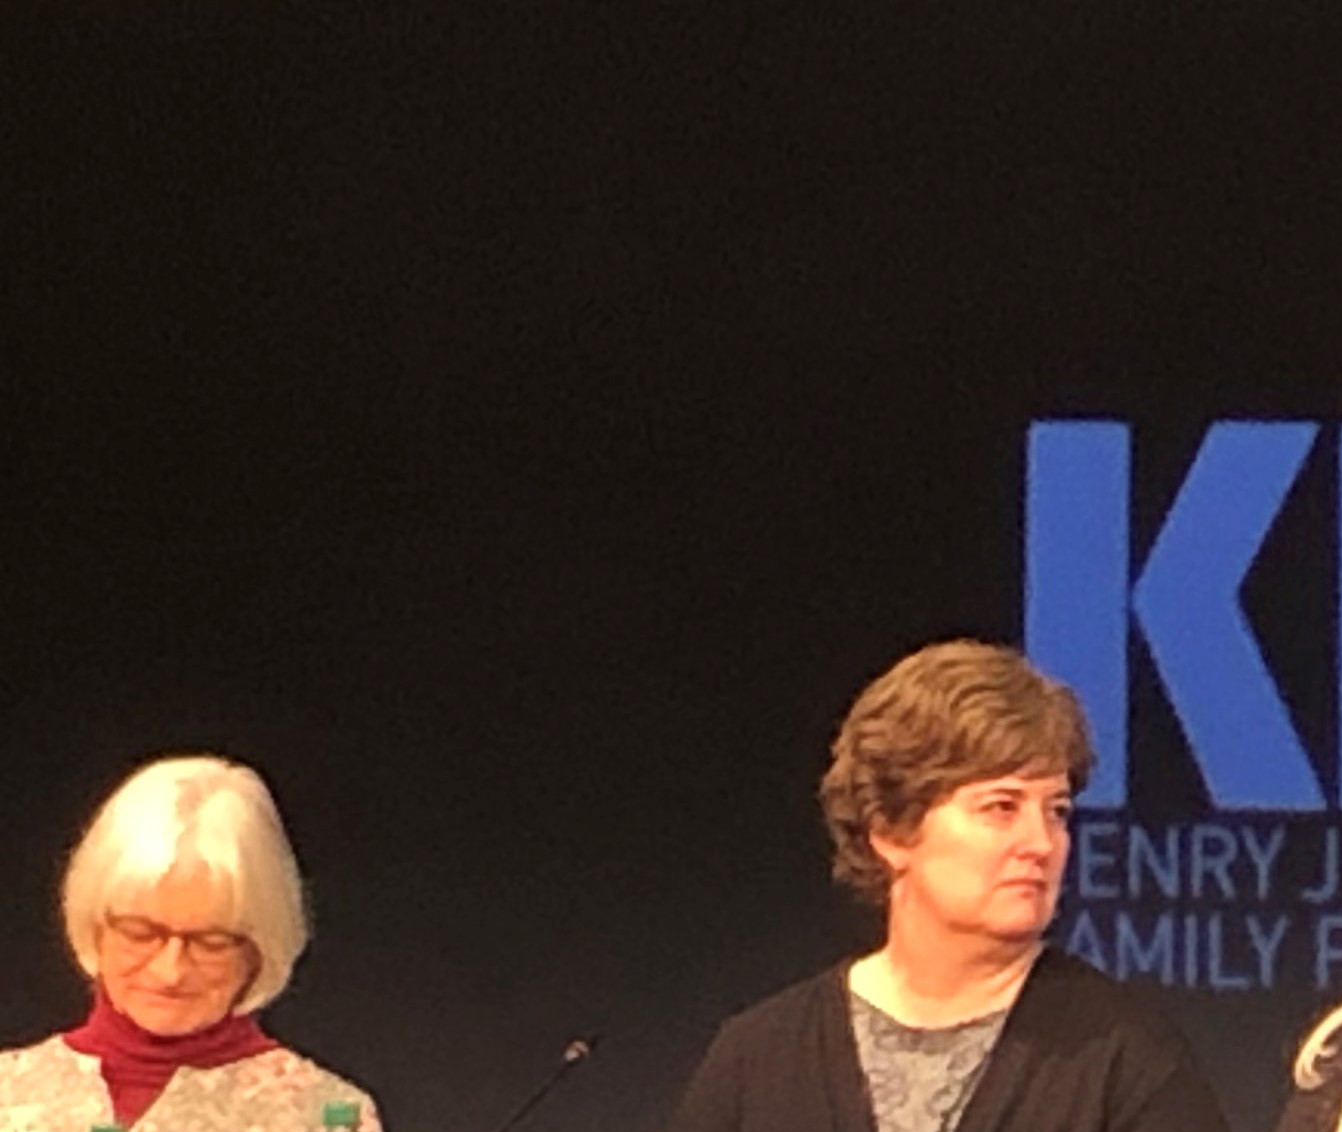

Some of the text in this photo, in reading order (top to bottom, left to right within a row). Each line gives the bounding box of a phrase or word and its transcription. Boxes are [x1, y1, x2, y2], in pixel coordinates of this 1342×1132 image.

[1076, 821, 1285, 901] ENRY
[1302, 825, 1339, 903] J
[1064, 909, 1291, 990] AMILY
